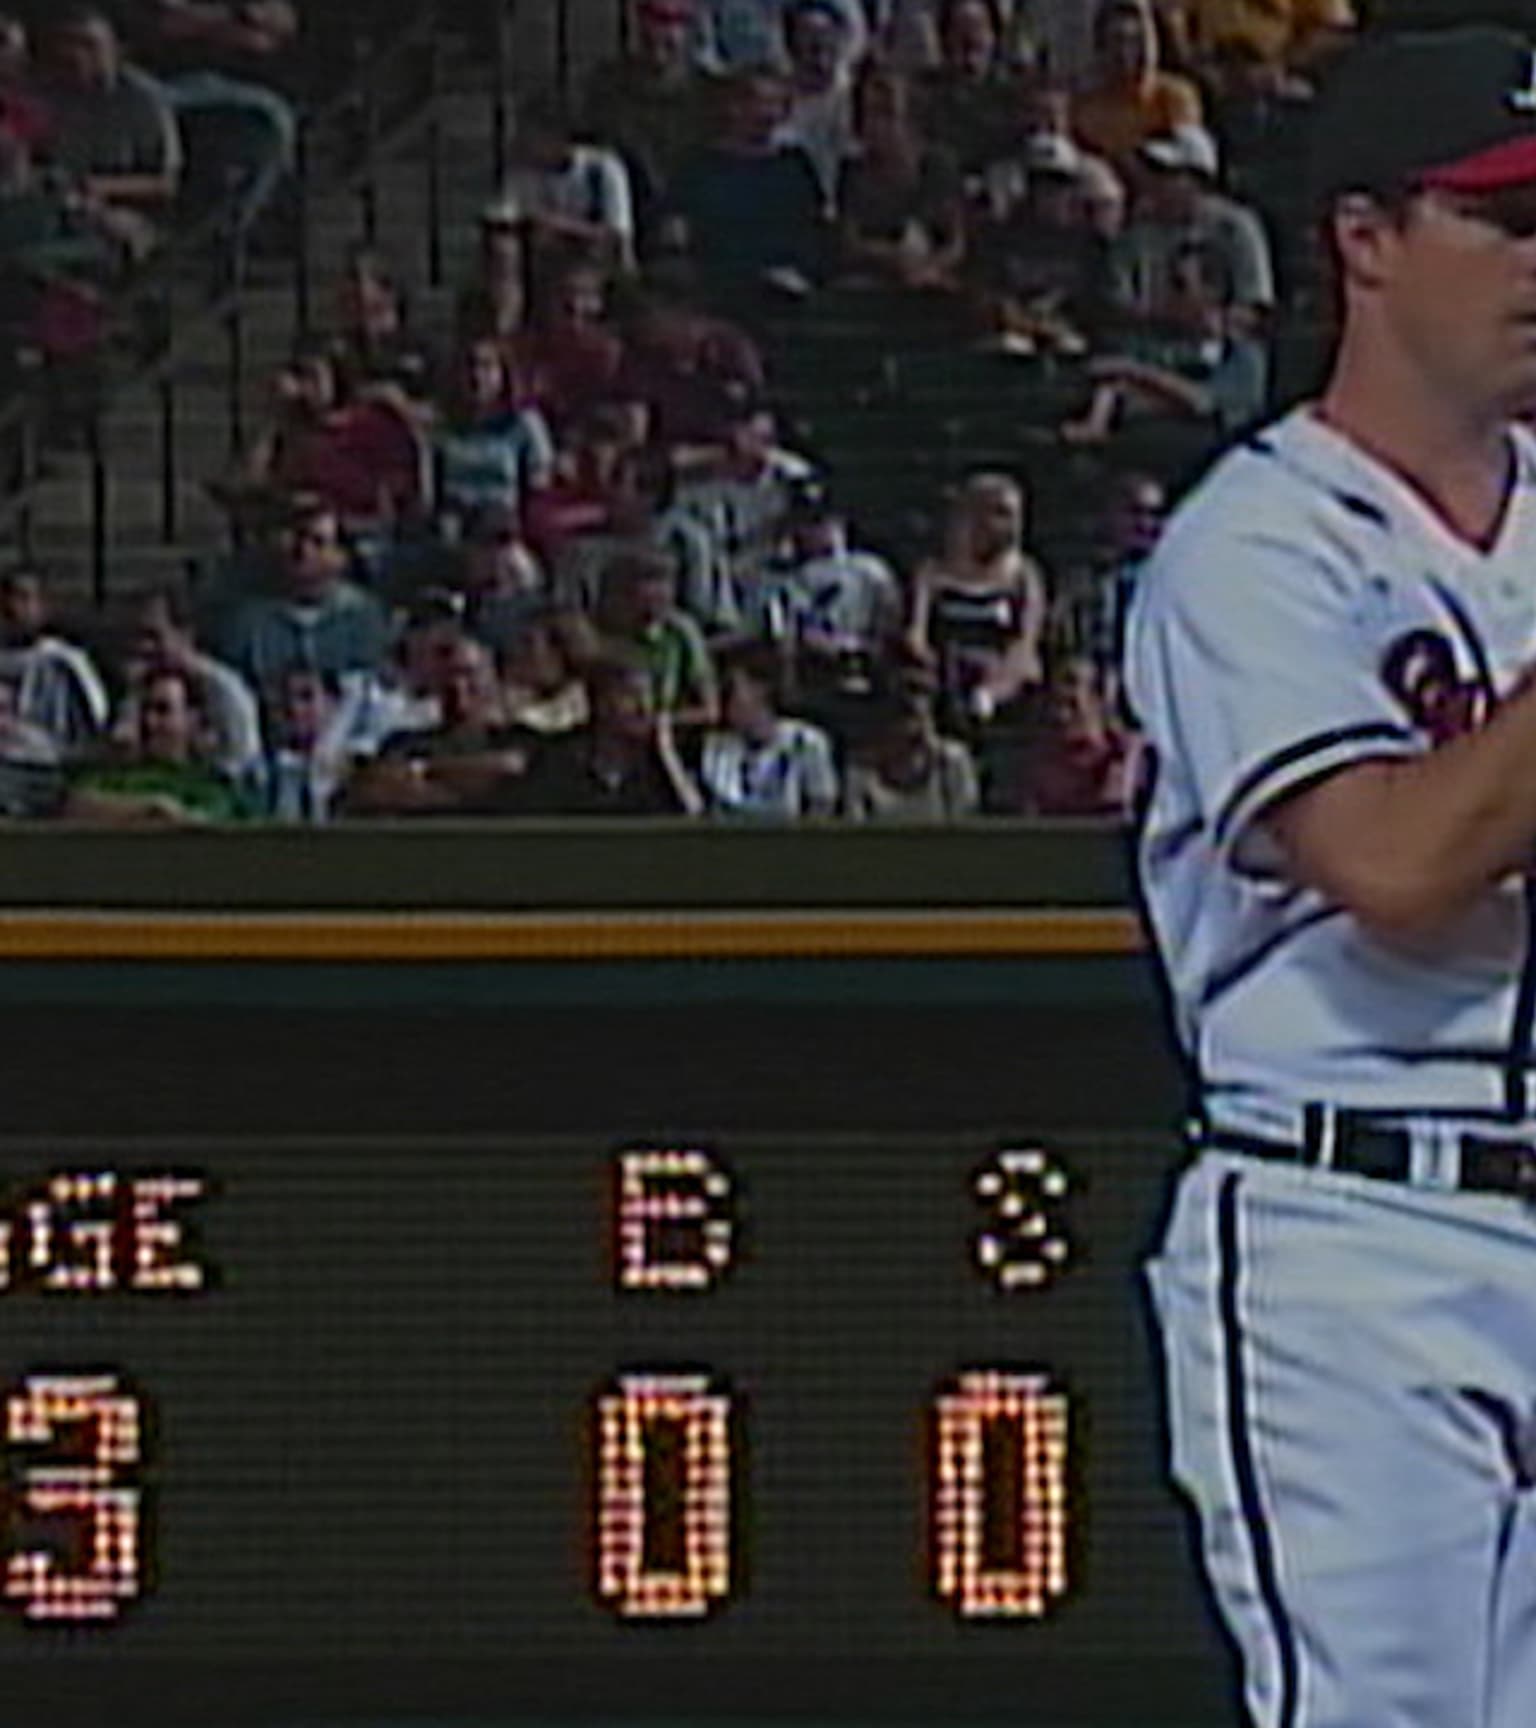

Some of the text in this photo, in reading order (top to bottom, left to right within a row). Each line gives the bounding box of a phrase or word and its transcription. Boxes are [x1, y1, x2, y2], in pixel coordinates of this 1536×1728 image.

[0, 1172, 204, 1289] GE
[618, 1151, 730, 1288] B
[977, 1151, 1068, 1285] S
[5, 1373, 141, 1618] 3
[599, 1373, 731, 1618] 0
[936, 1373, 1069, 1618] 0
